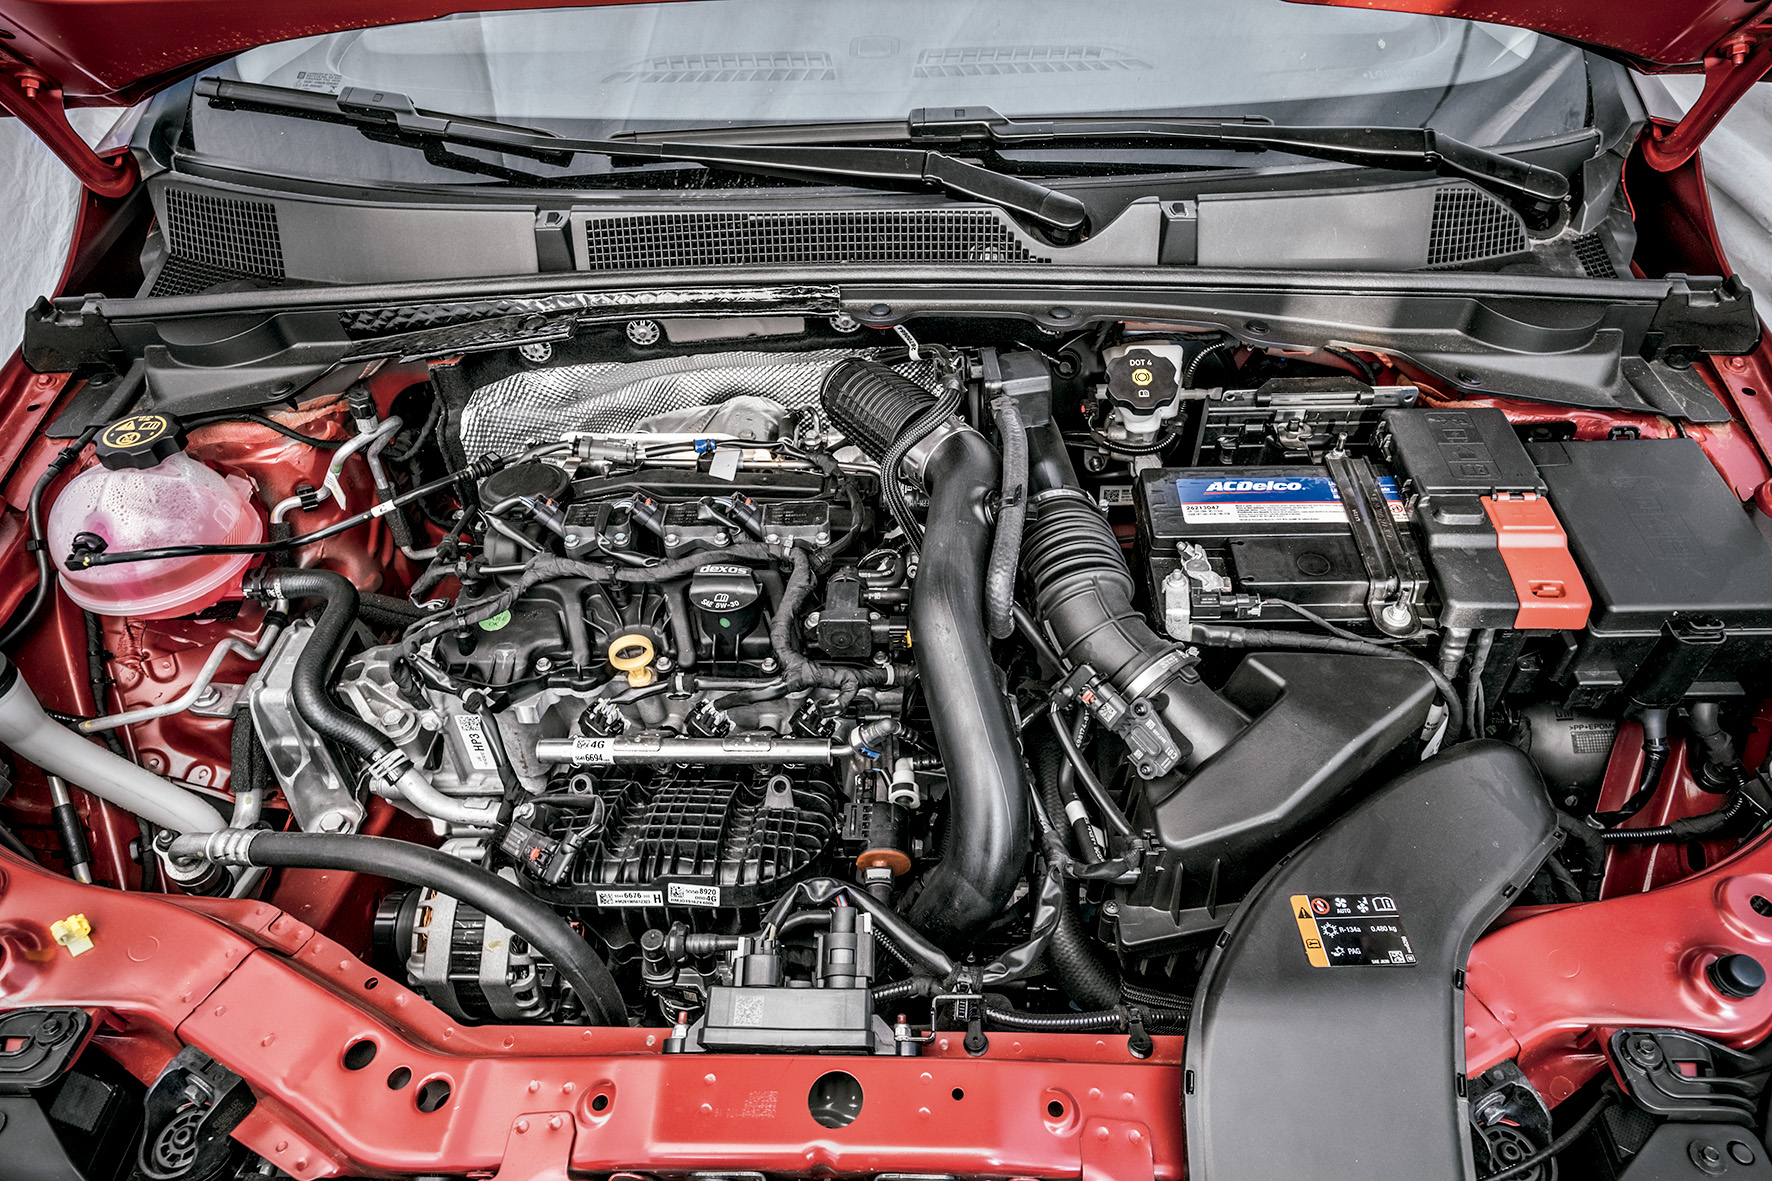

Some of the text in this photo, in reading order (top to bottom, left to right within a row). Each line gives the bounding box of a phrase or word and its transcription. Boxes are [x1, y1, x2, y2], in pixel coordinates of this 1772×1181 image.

[1205, 480, 1303, 492] ACDelco
[699, 564, 748, 575] dexos
[700, 598, 740, 609] SAE 5W-30
[468, 732, 485, 752] HP3
[590, 740, 605, 748] 4G
[699, 887, 717, 896] 8920
[653, 893, 662, 904] H
[1389, 925, 1398, 933] kg
[1347, 947, 1362, 955] PAG
